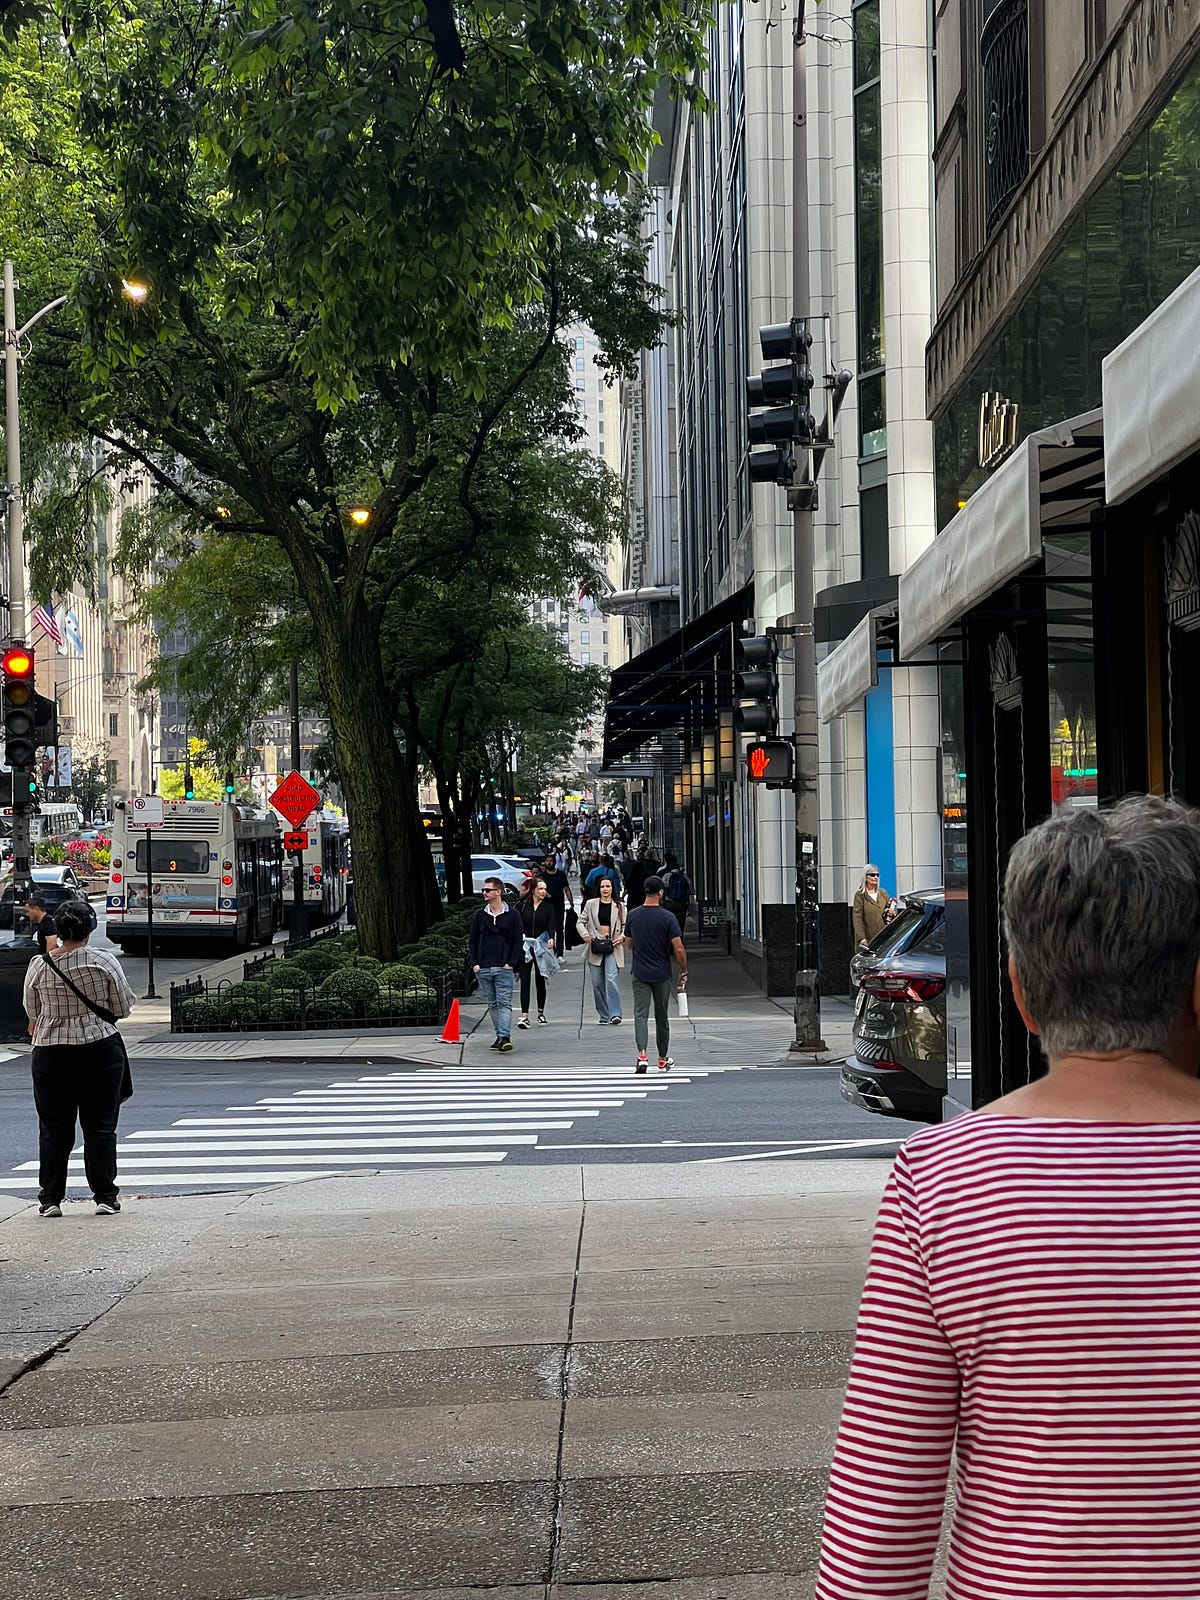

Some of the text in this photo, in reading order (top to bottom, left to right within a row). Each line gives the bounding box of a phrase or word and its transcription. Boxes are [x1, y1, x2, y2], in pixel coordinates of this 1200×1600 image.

[273, 794, 318, 803] CONSTRUCTION
[187, 805, 206, 814] 7966
[285, 804, 306, 813] AHEAD
[169, 860, 177, 871] 3
